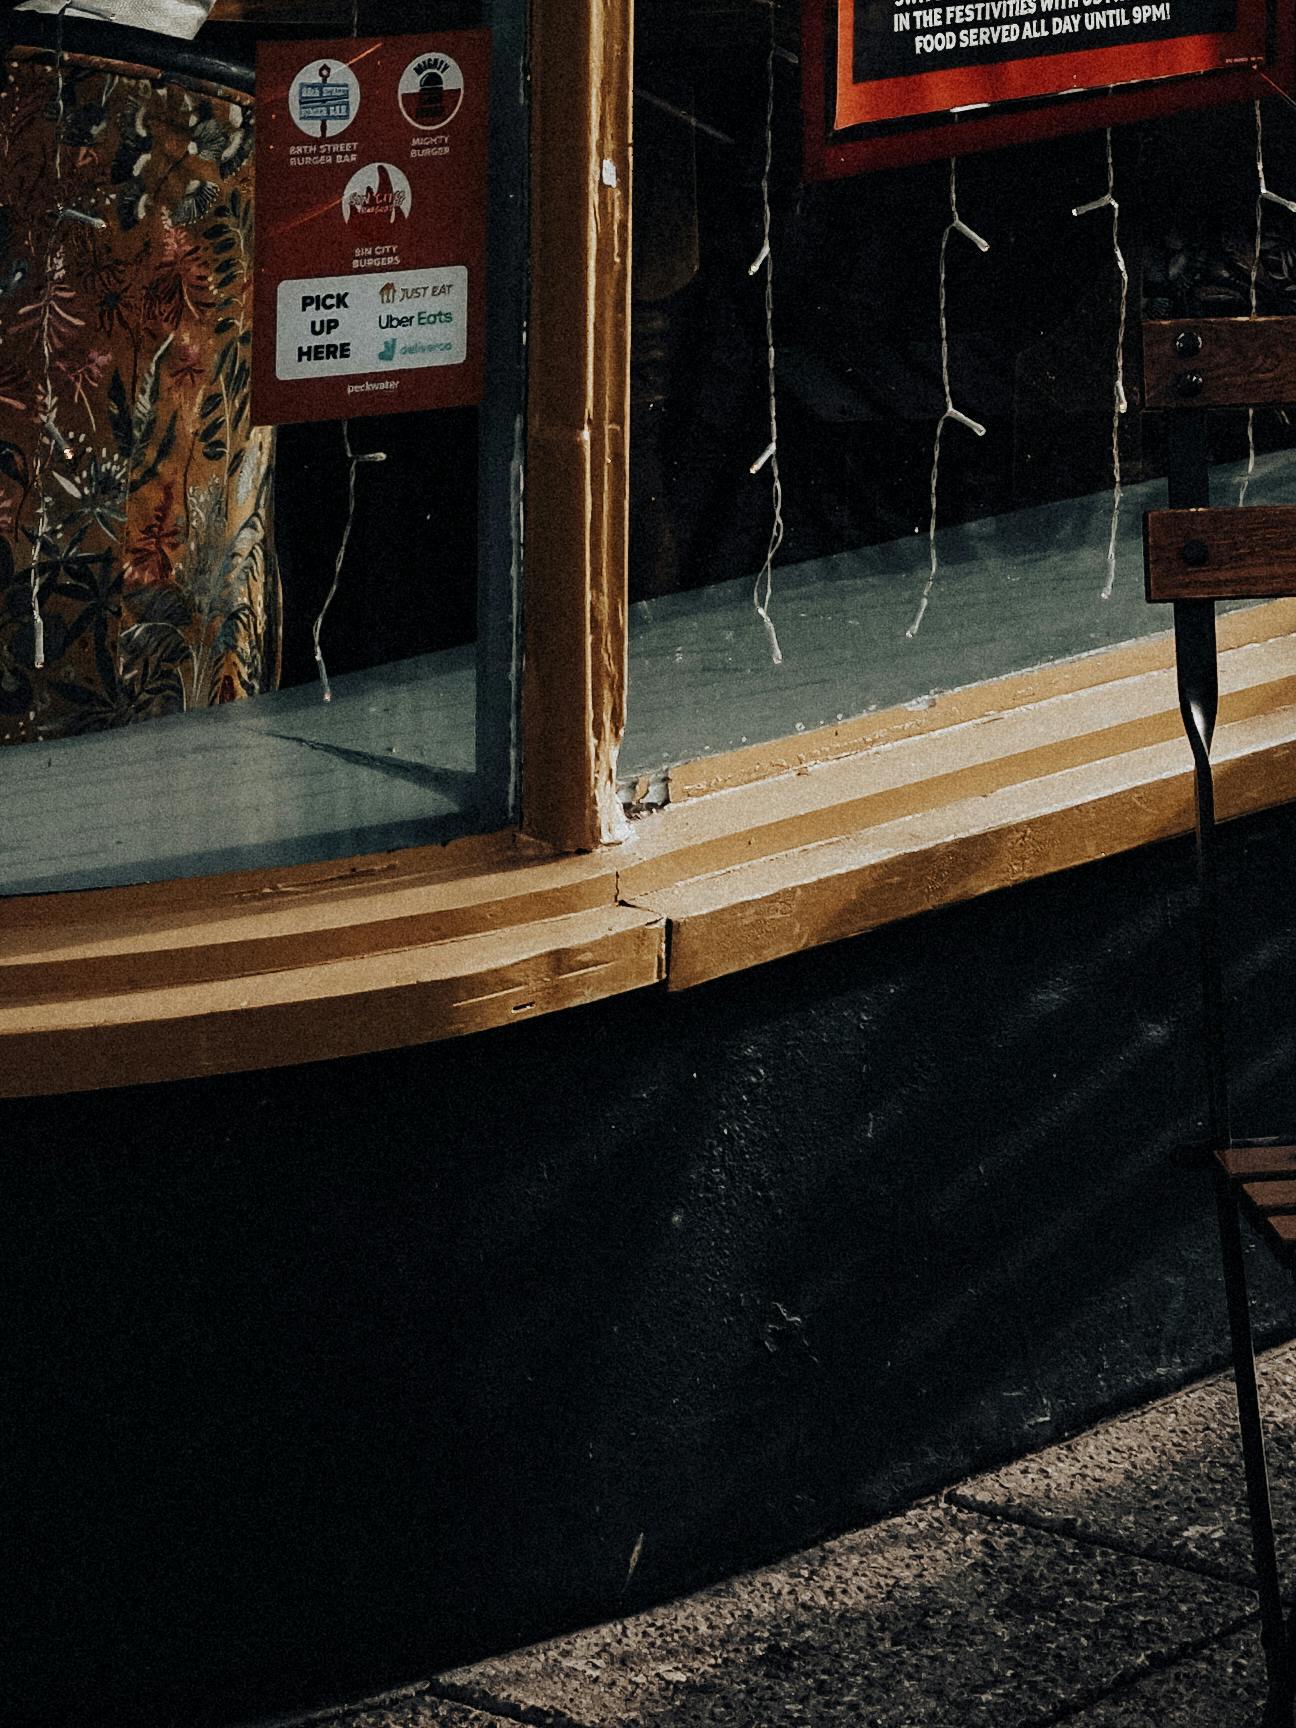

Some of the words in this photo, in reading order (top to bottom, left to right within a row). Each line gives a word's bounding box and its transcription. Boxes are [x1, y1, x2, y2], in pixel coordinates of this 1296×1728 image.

[893, 13, 911, 32] IN
[912, 8, 943, 29] THE
[914, 34, 957, 56] FOOD
[959, 24, 1020, 47] SERVED
[1022, 21, 1049, 40] ALL
[1052, 15, 1082, 35] DAY
[1083, 8, 1130, 31] UNTIL
[1132, 2, 1171, 25] 9PM!
[413, 57, 449, 75] MIGHTY
[289, 155, 332, 166] BURGER
[410, 146, 450, 158] BURGER
[374, 245, 398, 255] CITY
[352, 256, 401, 268] BURGERS
[302, 292, 350, 312] PICK
[399, 286, 429, 302] JUST
[432, 284, 453, 297] EAT
[311, 318, 339, 336] UP
[378, 313, 414, 330] Uber
[418, 310, 453, 326] Eats
[297, 342, 351, 362] HERE
[347, 380, 400, 394] peckwater
